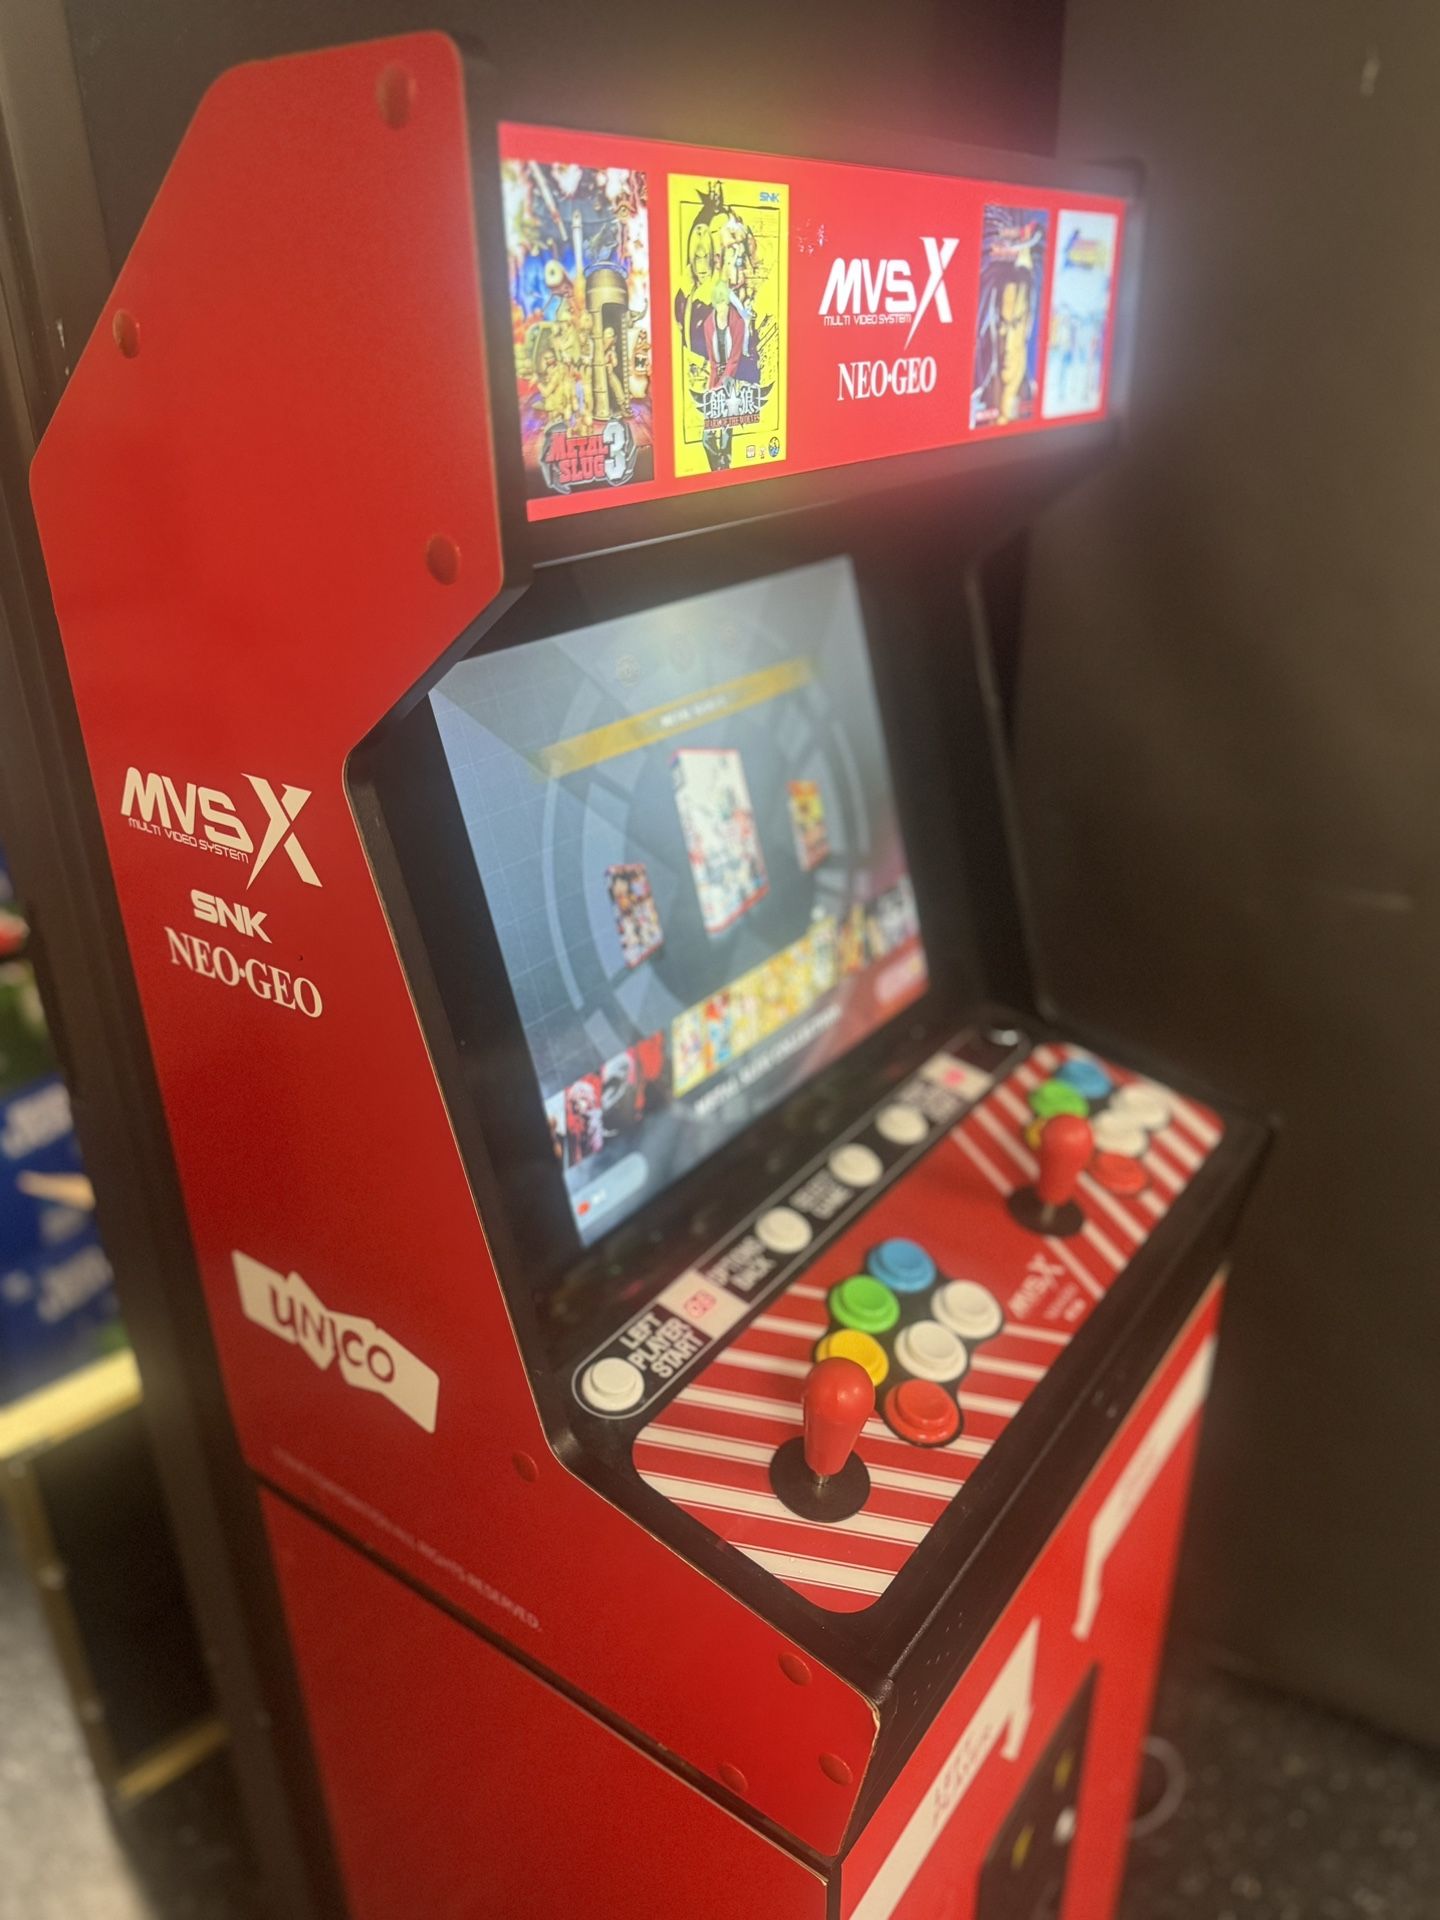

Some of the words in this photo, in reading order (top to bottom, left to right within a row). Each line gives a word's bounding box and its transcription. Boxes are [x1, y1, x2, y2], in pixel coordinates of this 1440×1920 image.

[759, 192, 779, 203] SNK
[824, 315, 850, 326] MULTI
[854, 315, 877, 325] VIDEO
[879, 314, 911, 325] SYSTEM
[545, 432, 609, 463] METAL
[603, 421, 626, 480] 3
[559, 455, 605, 483] SLUG
[128, 818, 161, 836] MULTI
[165, 828, 197, 849] VIDEO
[199, 839, 249, 864] SYSTEM
[190, 889, 273, 944] SNK
[270, 1285, 396, 1384] UNICO
[619, 1311, 662, 1350] LEFT
[627, 1318, 692, 1371] PLAYER
[651, 1332, 704, 1379] START
